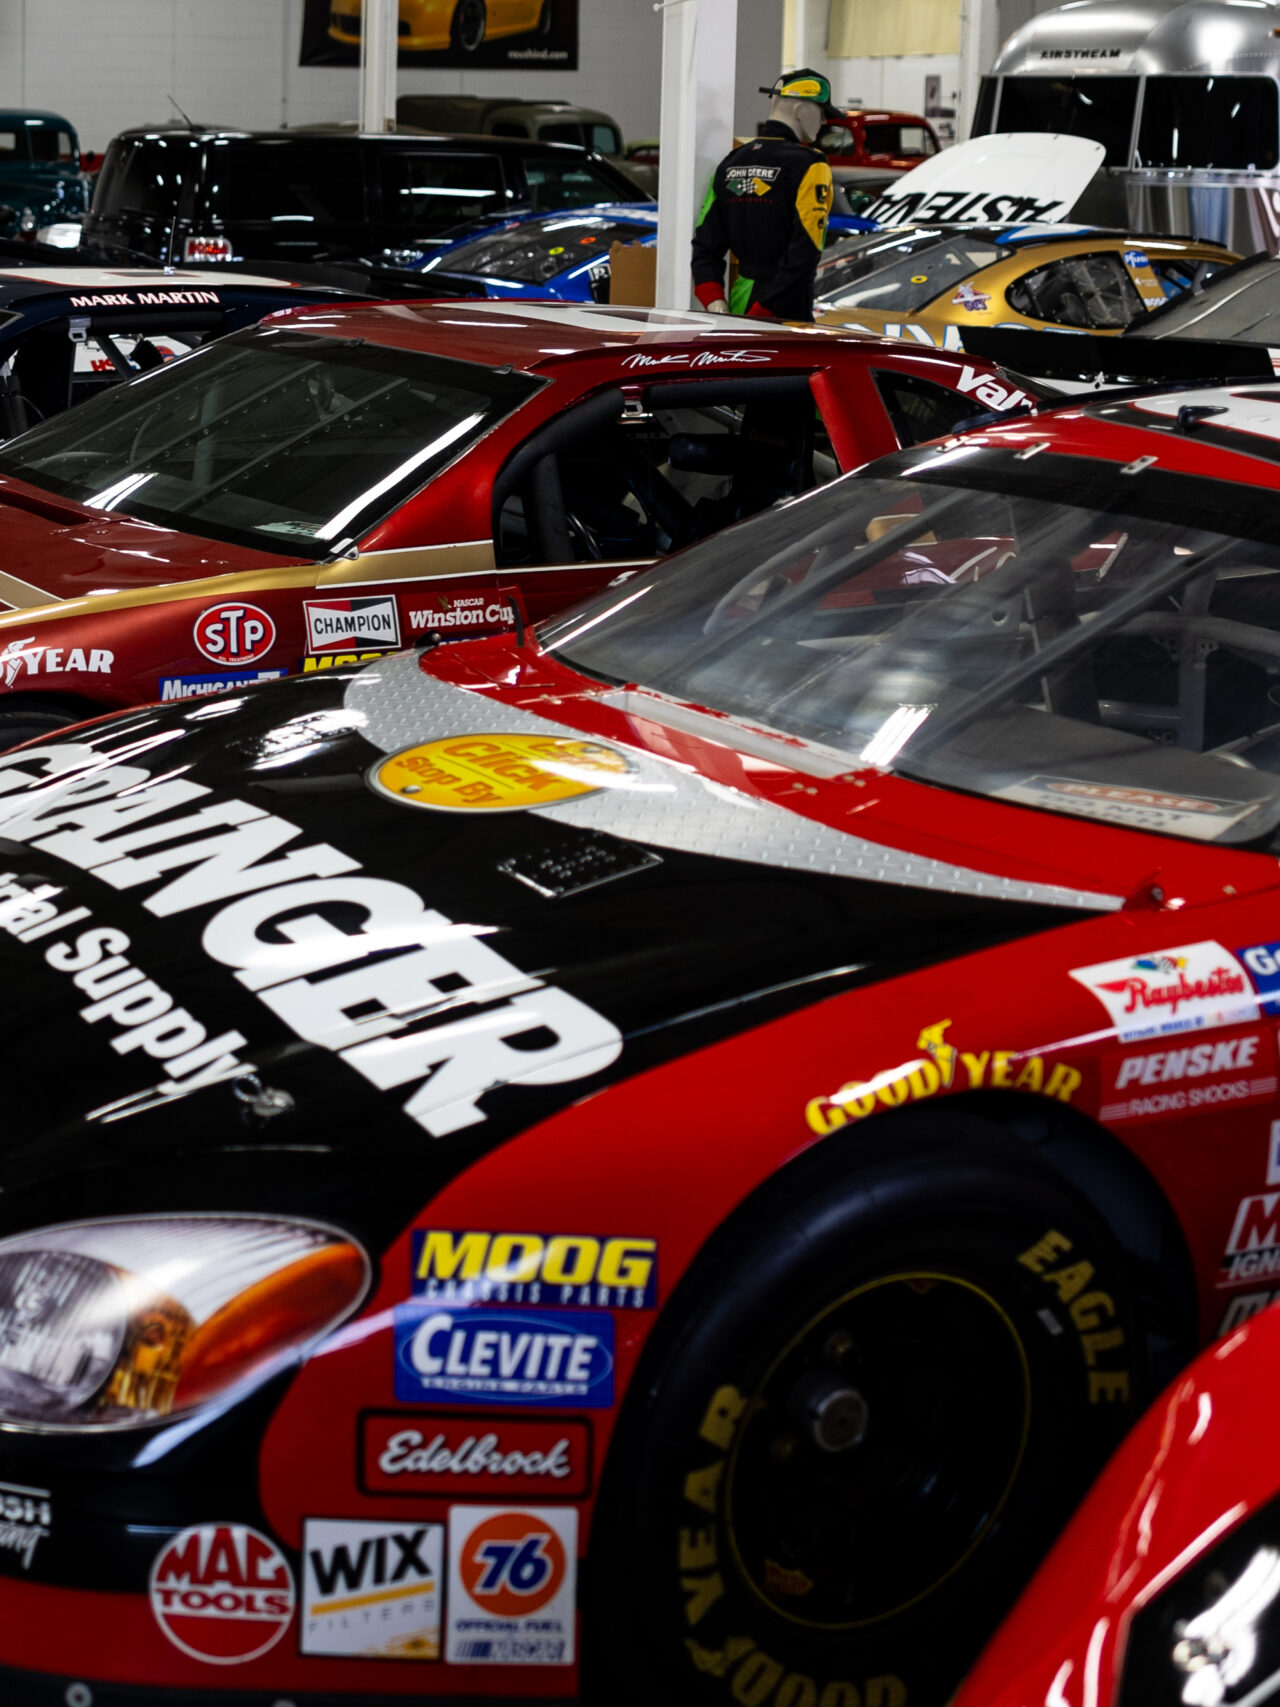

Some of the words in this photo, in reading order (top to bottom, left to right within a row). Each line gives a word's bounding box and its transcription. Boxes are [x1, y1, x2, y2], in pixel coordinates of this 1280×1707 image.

[1041, 48, 1122, 59] AIRSTREAM
[726, 168, 747, 179] JOHN
[748, 167, 775, 179] DEERE
[70, 293, 135, 307] MARK
[136, 291, 220, 305] MARTIN
[313, 613, 392, 635] CHAMPION
[409, 608, 484, 629] Winston
[484, 604, 515, 625] Cup
[453, 597, 484, 609] NASCAR
[205, 609, 264, 654] STP
[396, 755, 463, 786] Stop
[453, 780, 506, 804] By
[442, 741, 569, 792] Click
[1062, 783, 1202, 810] PLEASE
[45, 926, 258, 1096] Supply
[1120, 966, 1245, 1017] Raybestos
[1114, 1036, 1260, 1090] PENSKE
[805, 1046, 1082, 1137] GOODYEAR
[1128, 1092, 1187, 1116] RACING
[1188, 1081, 1249, 1105] SHOCKS
[416, 1231, 656, 1289] MOOG
[425, 1278, 542, 1305] CHASSIS
[561, 1283, 646, 1309] PARTS
[1017, 1229, 1131, 1404] EAGLE
[410, 1312, 599, 1382] CLEVITE
[378, 1429, 571, 1478] Edelbrock
[155, 1526, 291, 1590] MAC
[309, 1528, 433, 1597] WIX
[473, 1533, 552, 1597] 76
[154, 1587, 293, 1617] TOOLS
[308, 1599, 436, 1634] FILTERS
[455, 1618, 520, 1634] OFFICIAL
[525, 1620, 563, 1634] FUEL
